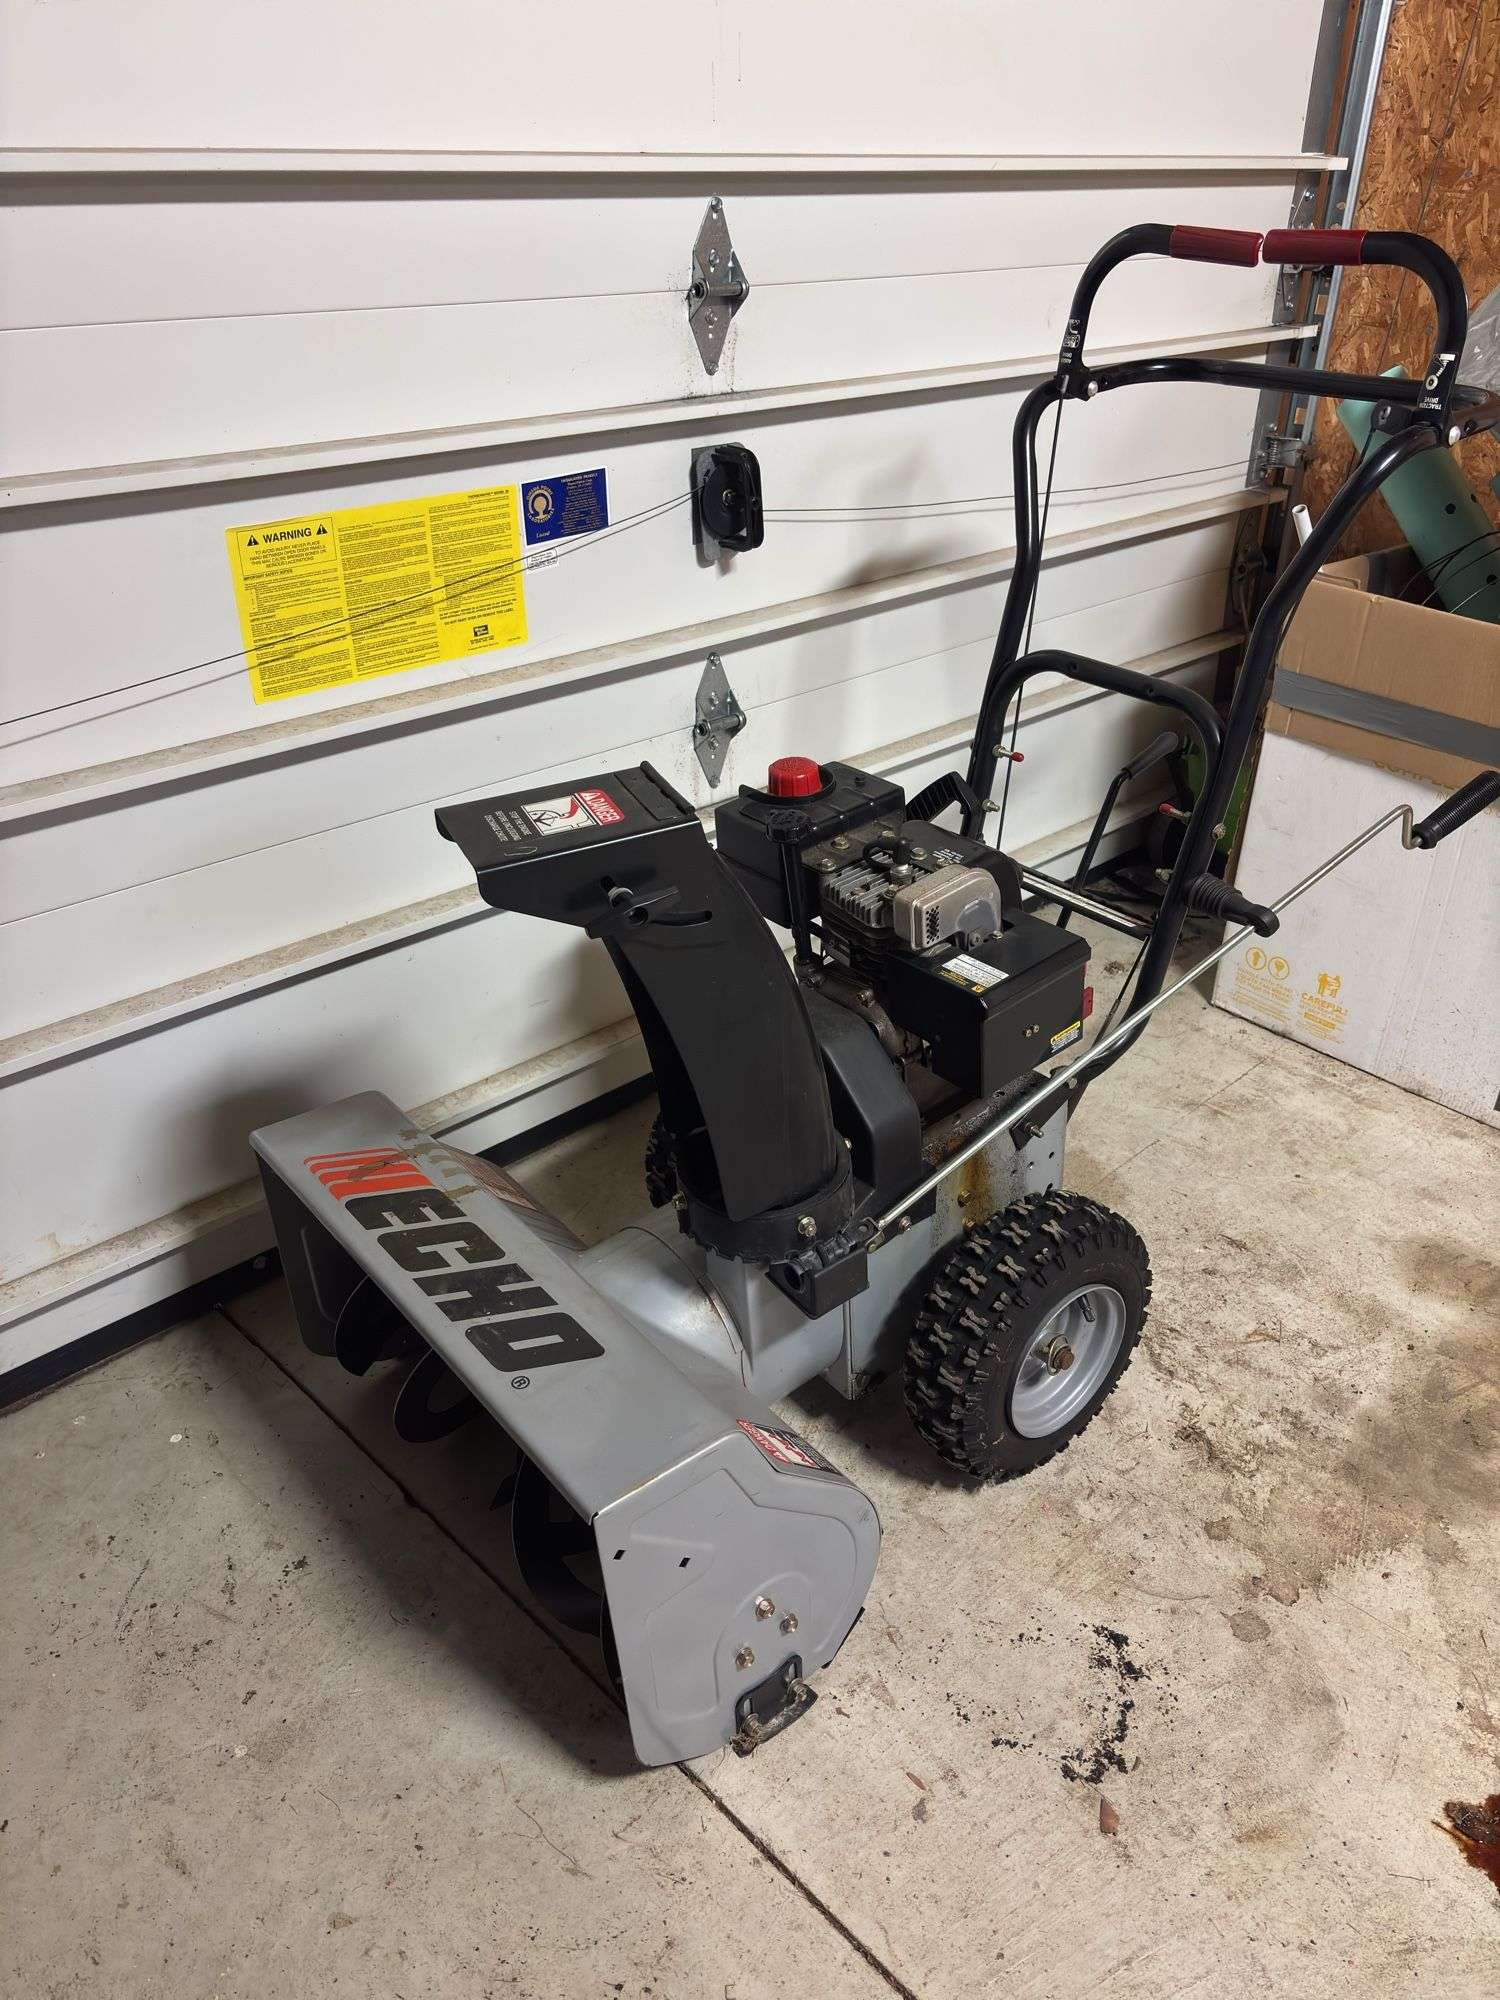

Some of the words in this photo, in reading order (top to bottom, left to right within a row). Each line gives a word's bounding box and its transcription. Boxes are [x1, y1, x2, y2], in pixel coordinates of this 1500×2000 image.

[263, 527, 312, 543] WARNING
[590, 793, 621, 823] DANGER
[345, 1188, 605, 1372] ECHO
